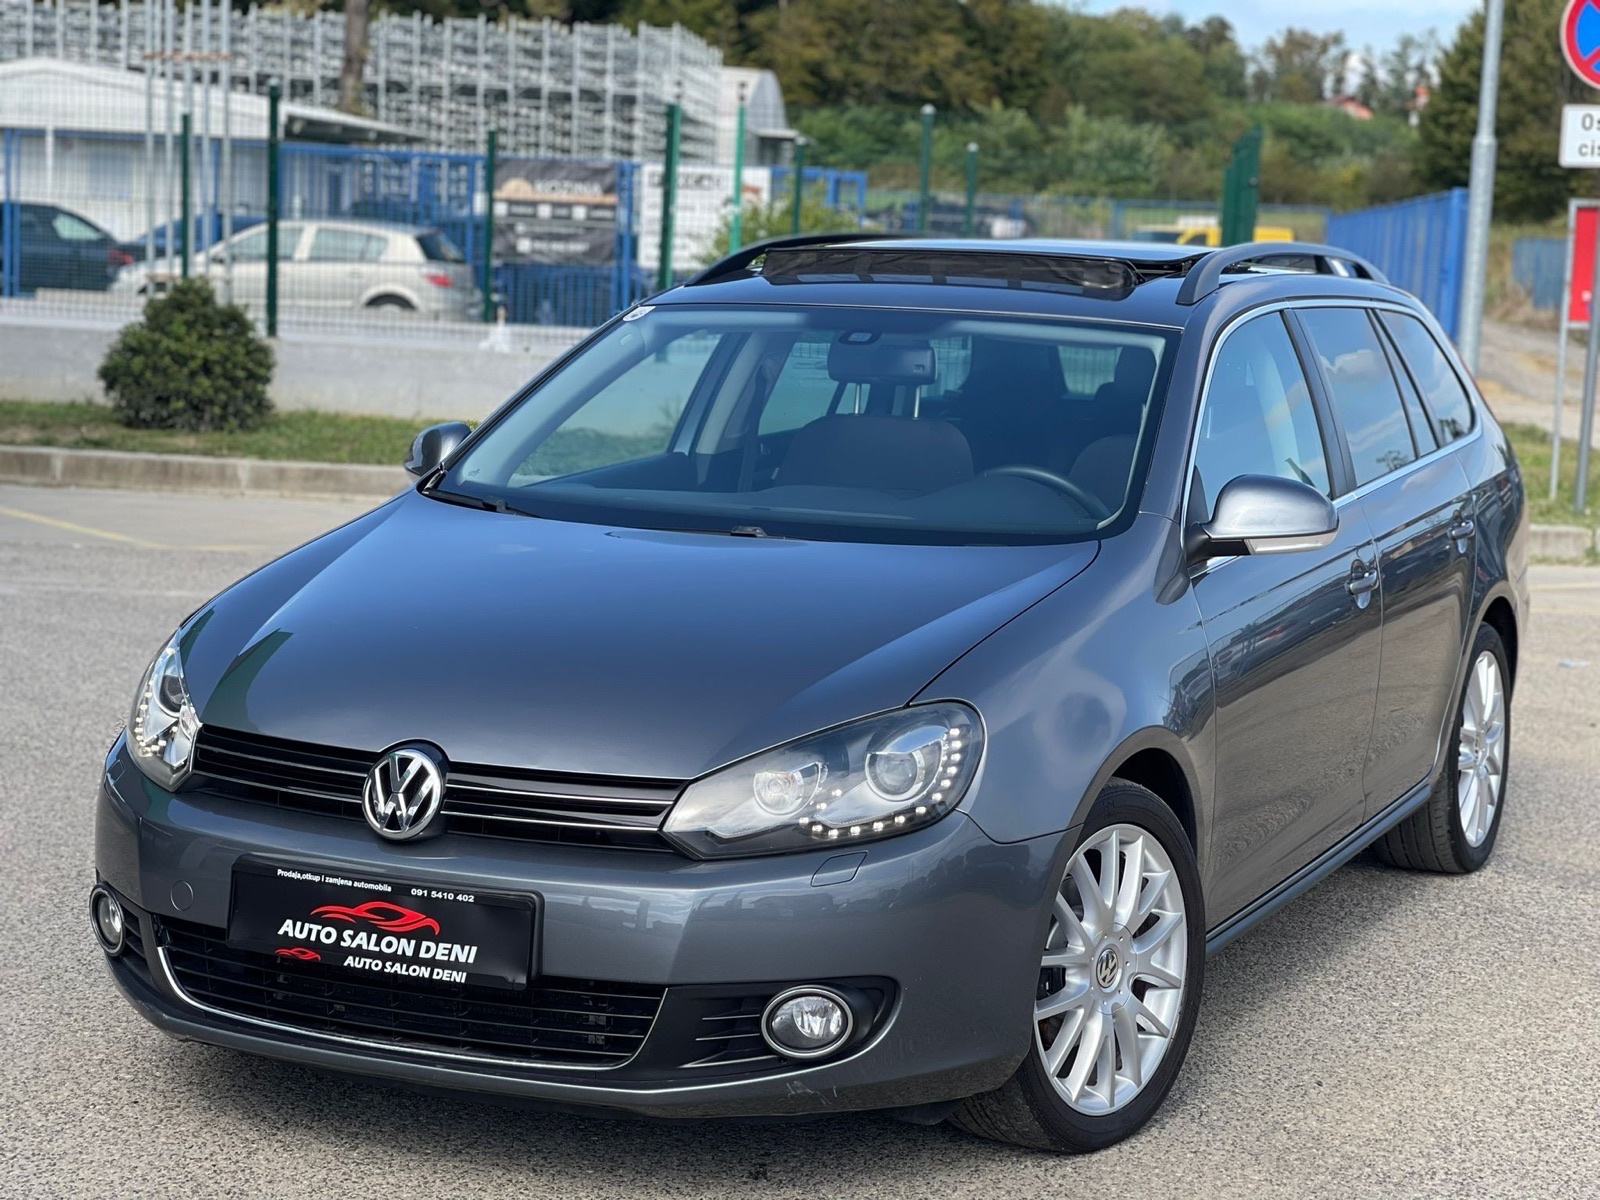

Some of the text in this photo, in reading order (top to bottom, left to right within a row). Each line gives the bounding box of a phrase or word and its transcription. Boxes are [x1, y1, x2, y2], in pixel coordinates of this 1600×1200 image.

[366, 750, 439, 836] VW
[325, 876, 352, 886] zamjena
[411, 888, 475, 903] 091 5410 402
[278, 919, 478, 964] AUTO SALON DENI
[343, 956, 467, 984] AUTO SALON DENI
